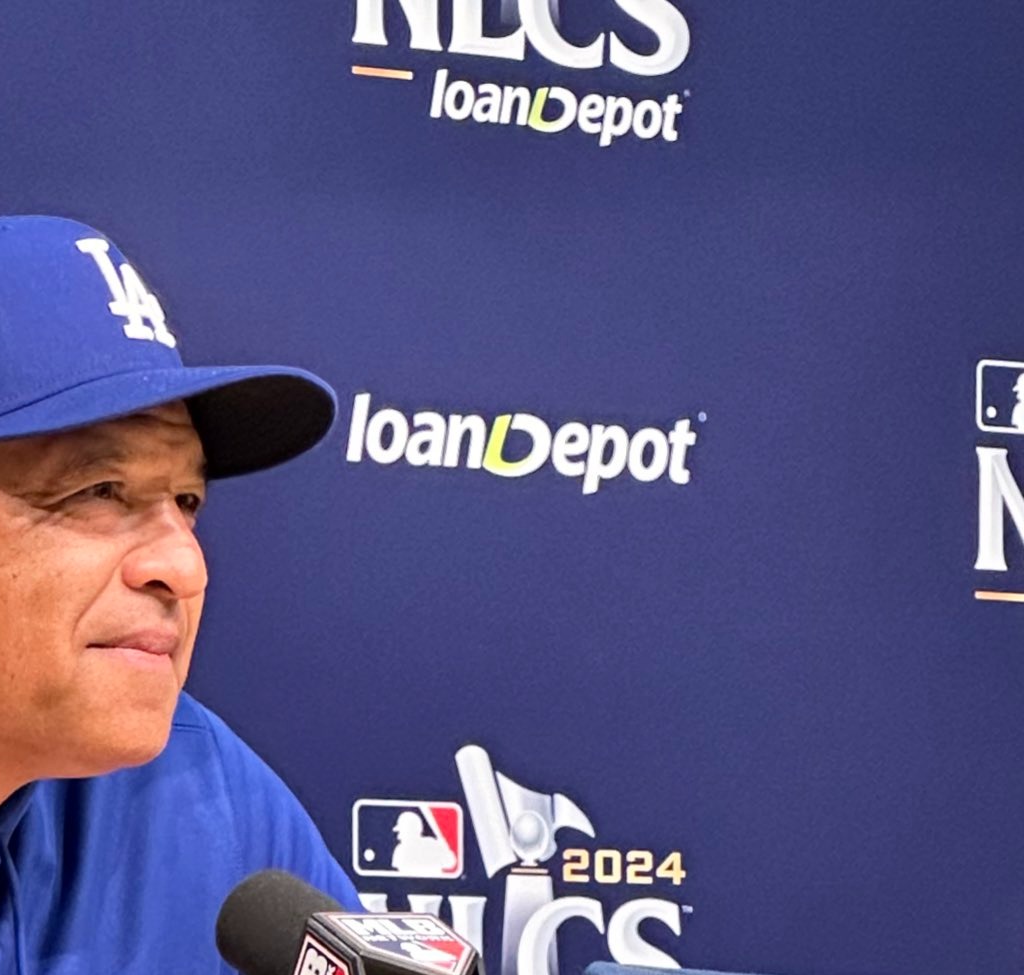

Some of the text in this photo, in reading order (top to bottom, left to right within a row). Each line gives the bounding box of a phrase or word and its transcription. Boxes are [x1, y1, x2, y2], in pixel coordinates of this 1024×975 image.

[430, 68, 683, 148] loanDepot
[75, 237, 176, 349] LA
[346, 392, 697, 495] loanDepot
[562, 848, 687, 886] 2024
[344, 917, 447, 937] MLB
